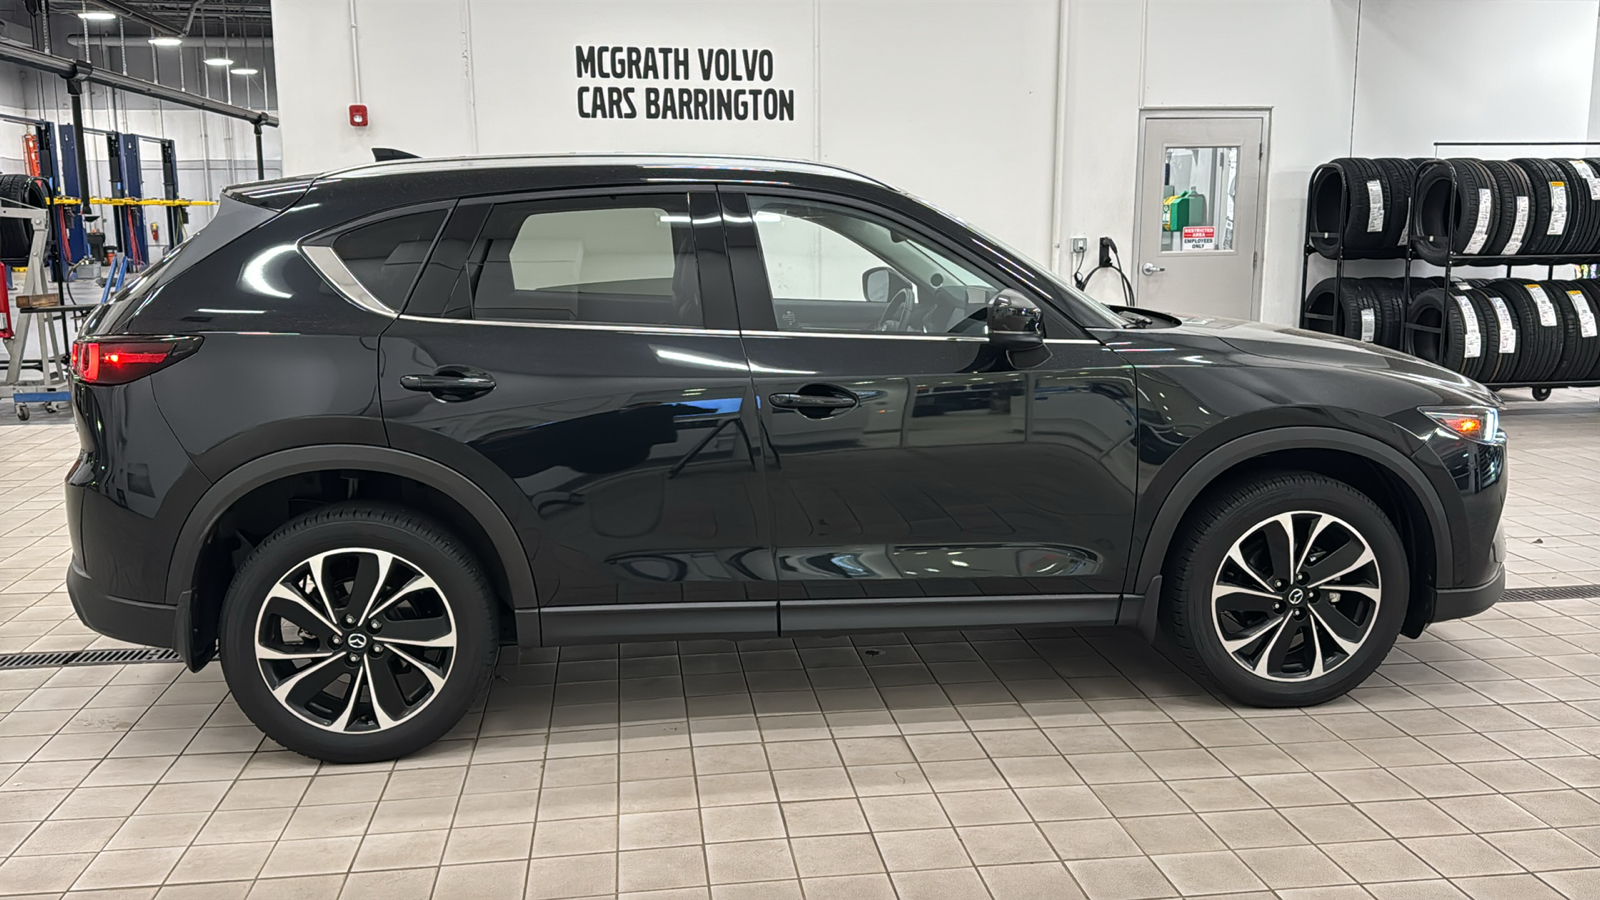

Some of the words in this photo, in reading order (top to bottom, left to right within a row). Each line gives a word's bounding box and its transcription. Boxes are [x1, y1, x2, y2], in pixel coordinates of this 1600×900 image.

[575, 45, 689, 80] MCGRATH
[698, 48, 773, 81] VOLVO
[577, 86, 637, 119] CARS
[645, 87, 794, 121] BARRINGTON
